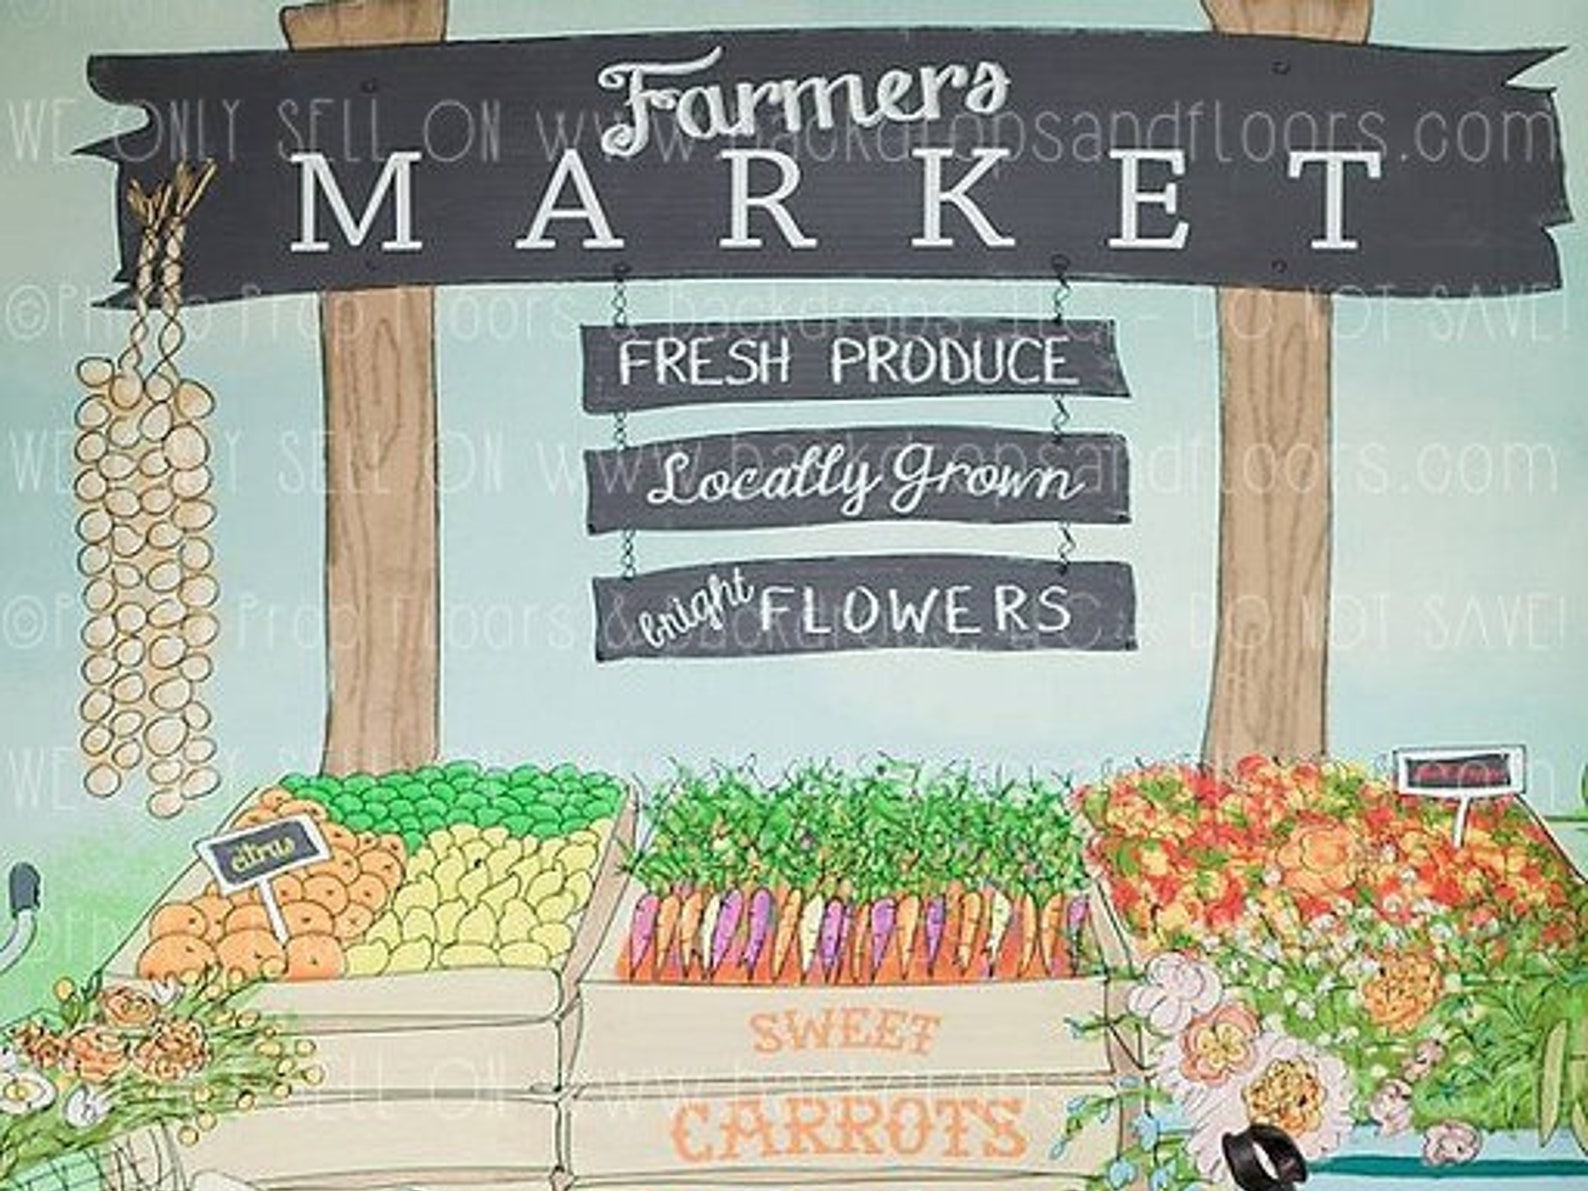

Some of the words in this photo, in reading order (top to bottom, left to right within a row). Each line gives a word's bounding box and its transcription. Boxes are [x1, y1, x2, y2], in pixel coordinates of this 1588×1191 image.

[598, 46, 1011, 157] Farmers
[290, 148, 1381, 253] MARKET
[619, 337, 791, 385] FRESH
[831, 335, 1080, 385] PRODUCE
[648, 443, 883, 516] Locally
[638, 566, 757, 649] bright
[760, 585, 1072, 635] FLOWERS
[232, 837, 295, 872] citrus
[748, 1006, 942, 1057] SWEET
[671, 1094, 1030, 1163] CARROTS
